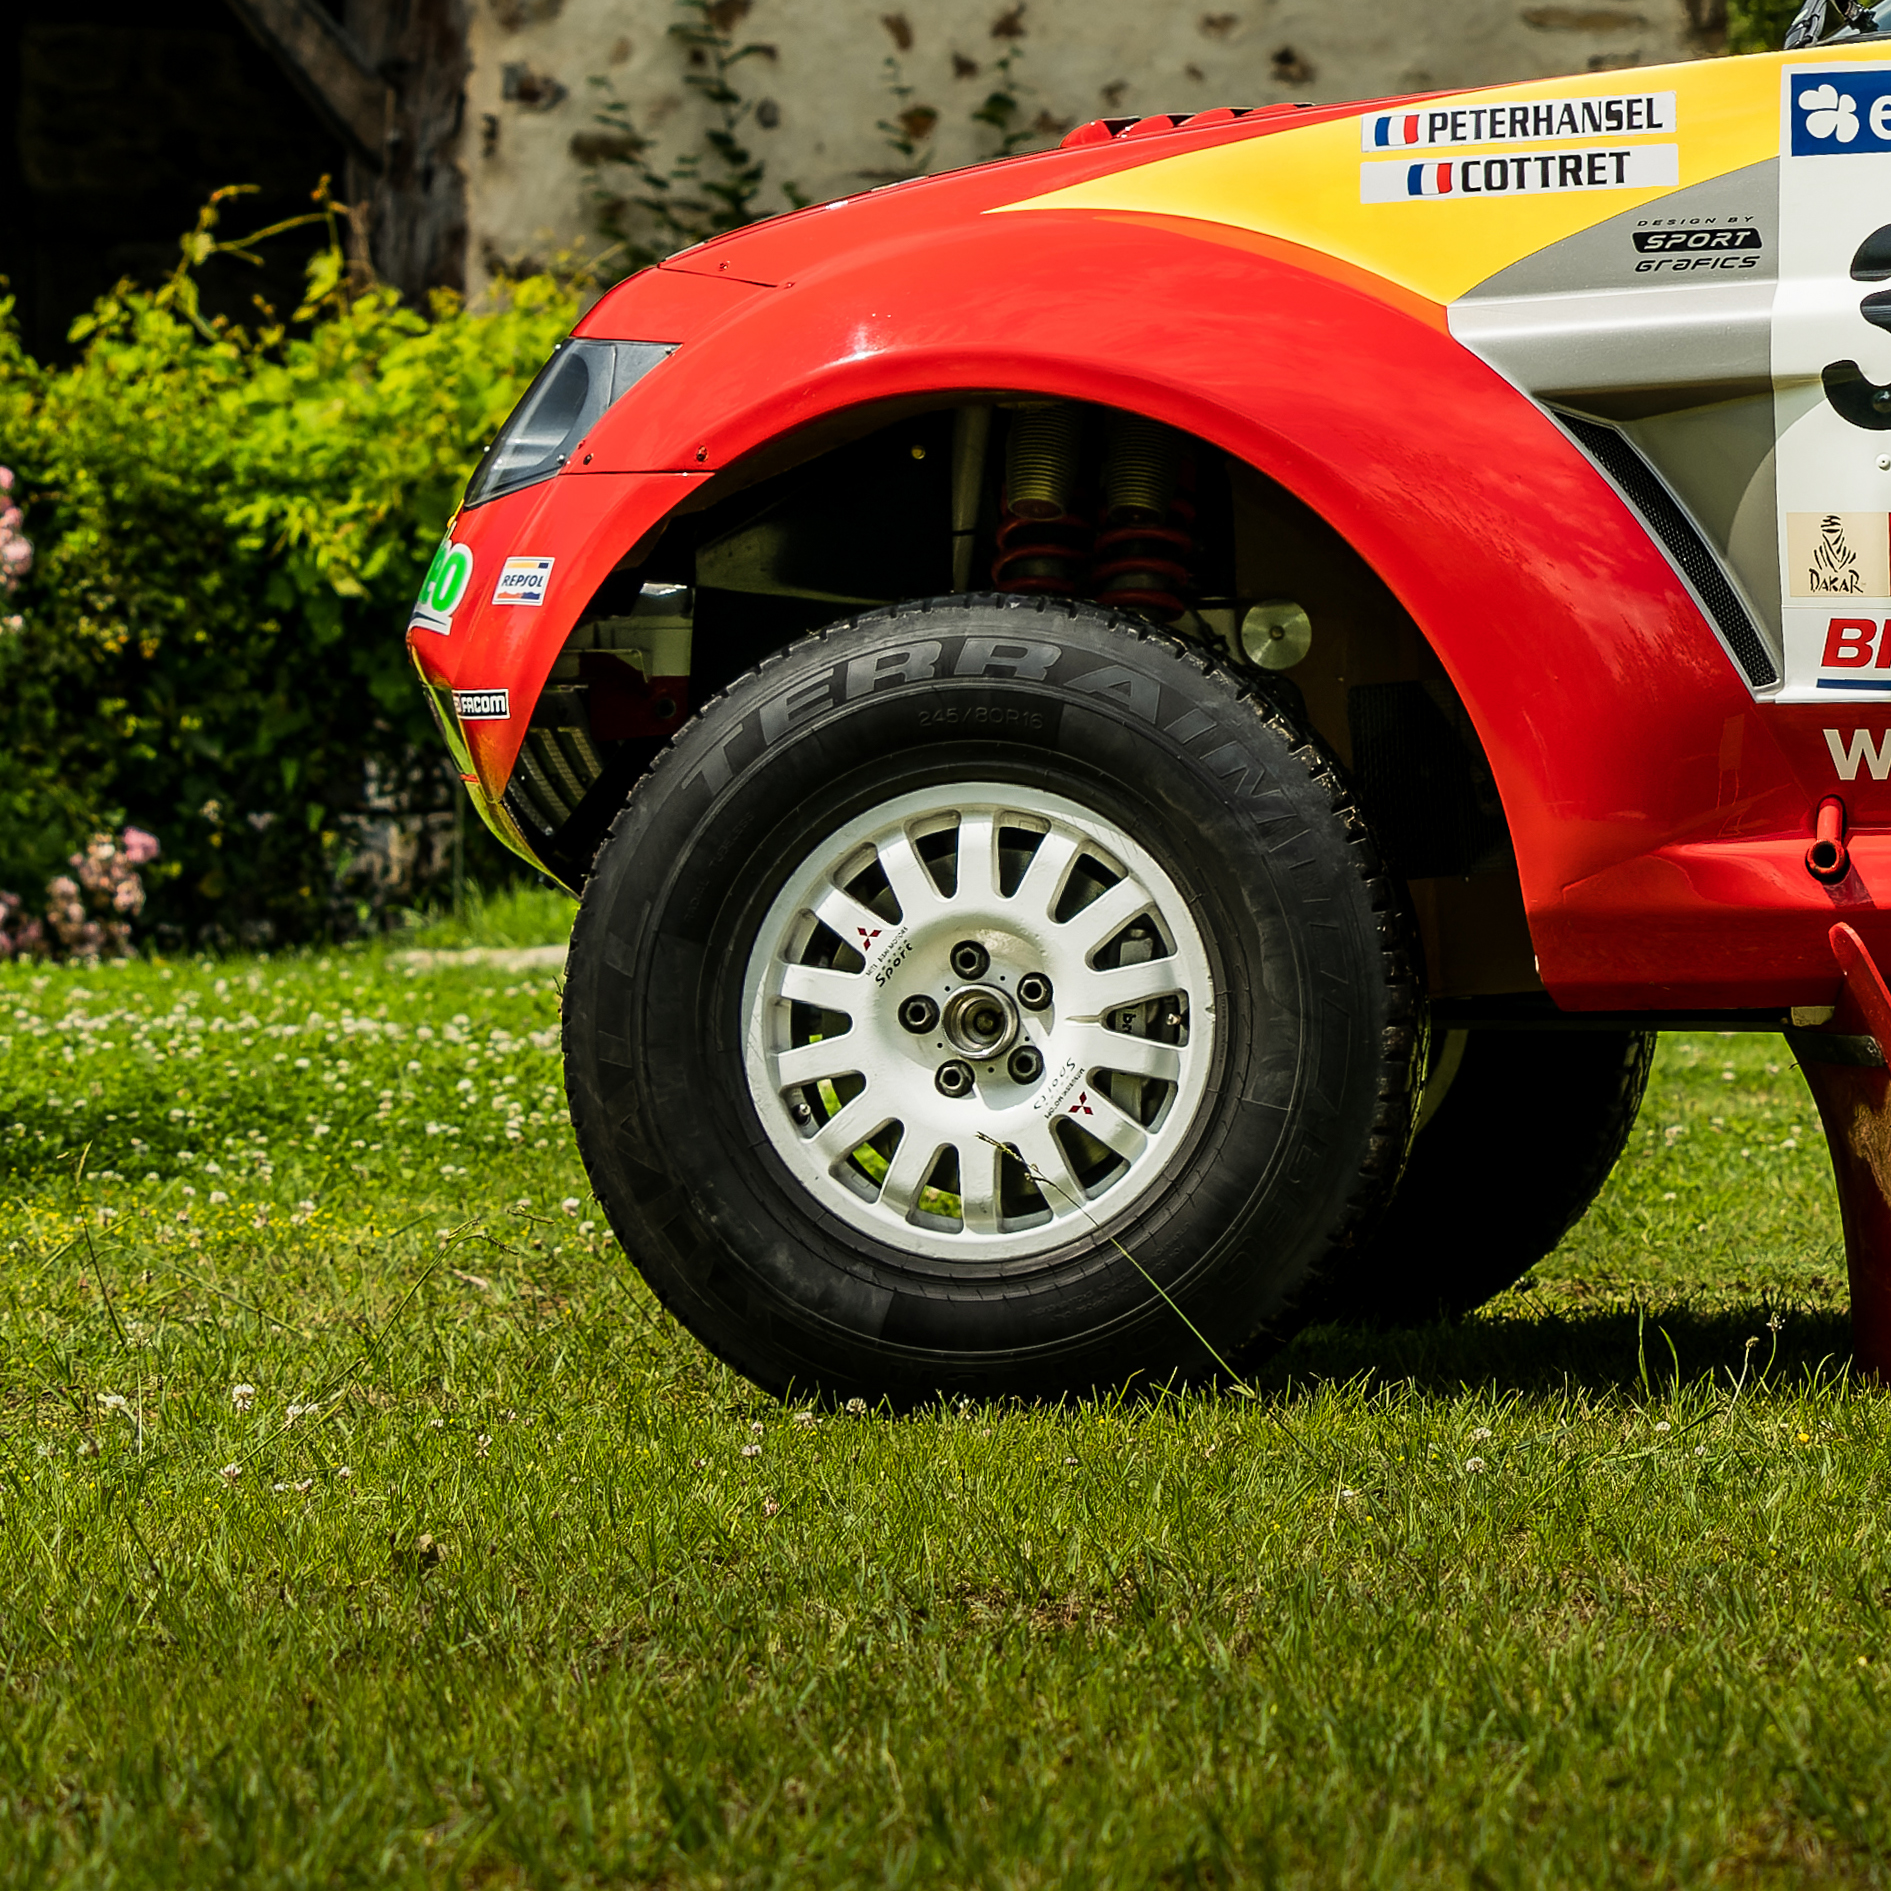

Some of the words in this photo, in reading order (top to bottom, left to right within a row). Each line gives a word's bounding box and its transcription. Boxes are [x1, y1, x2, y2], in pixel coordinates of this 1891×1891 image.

[1427, 97, 1663, 144] PETERHANSEL
[1461, 151, 1631, 193] COTTRET
[1637, 217, 1717, 227] DESIGN
[1728, 215, 1754, 224] BY
[1644, 230, 1752, 250] SPORT
[501, 574, 545, 588] REPSOL
[1808, 567, 1863, 594] DAKAR
[460, 694, 506, 714] FACOM
[678, 636, 1300, 836] TERRAIN
